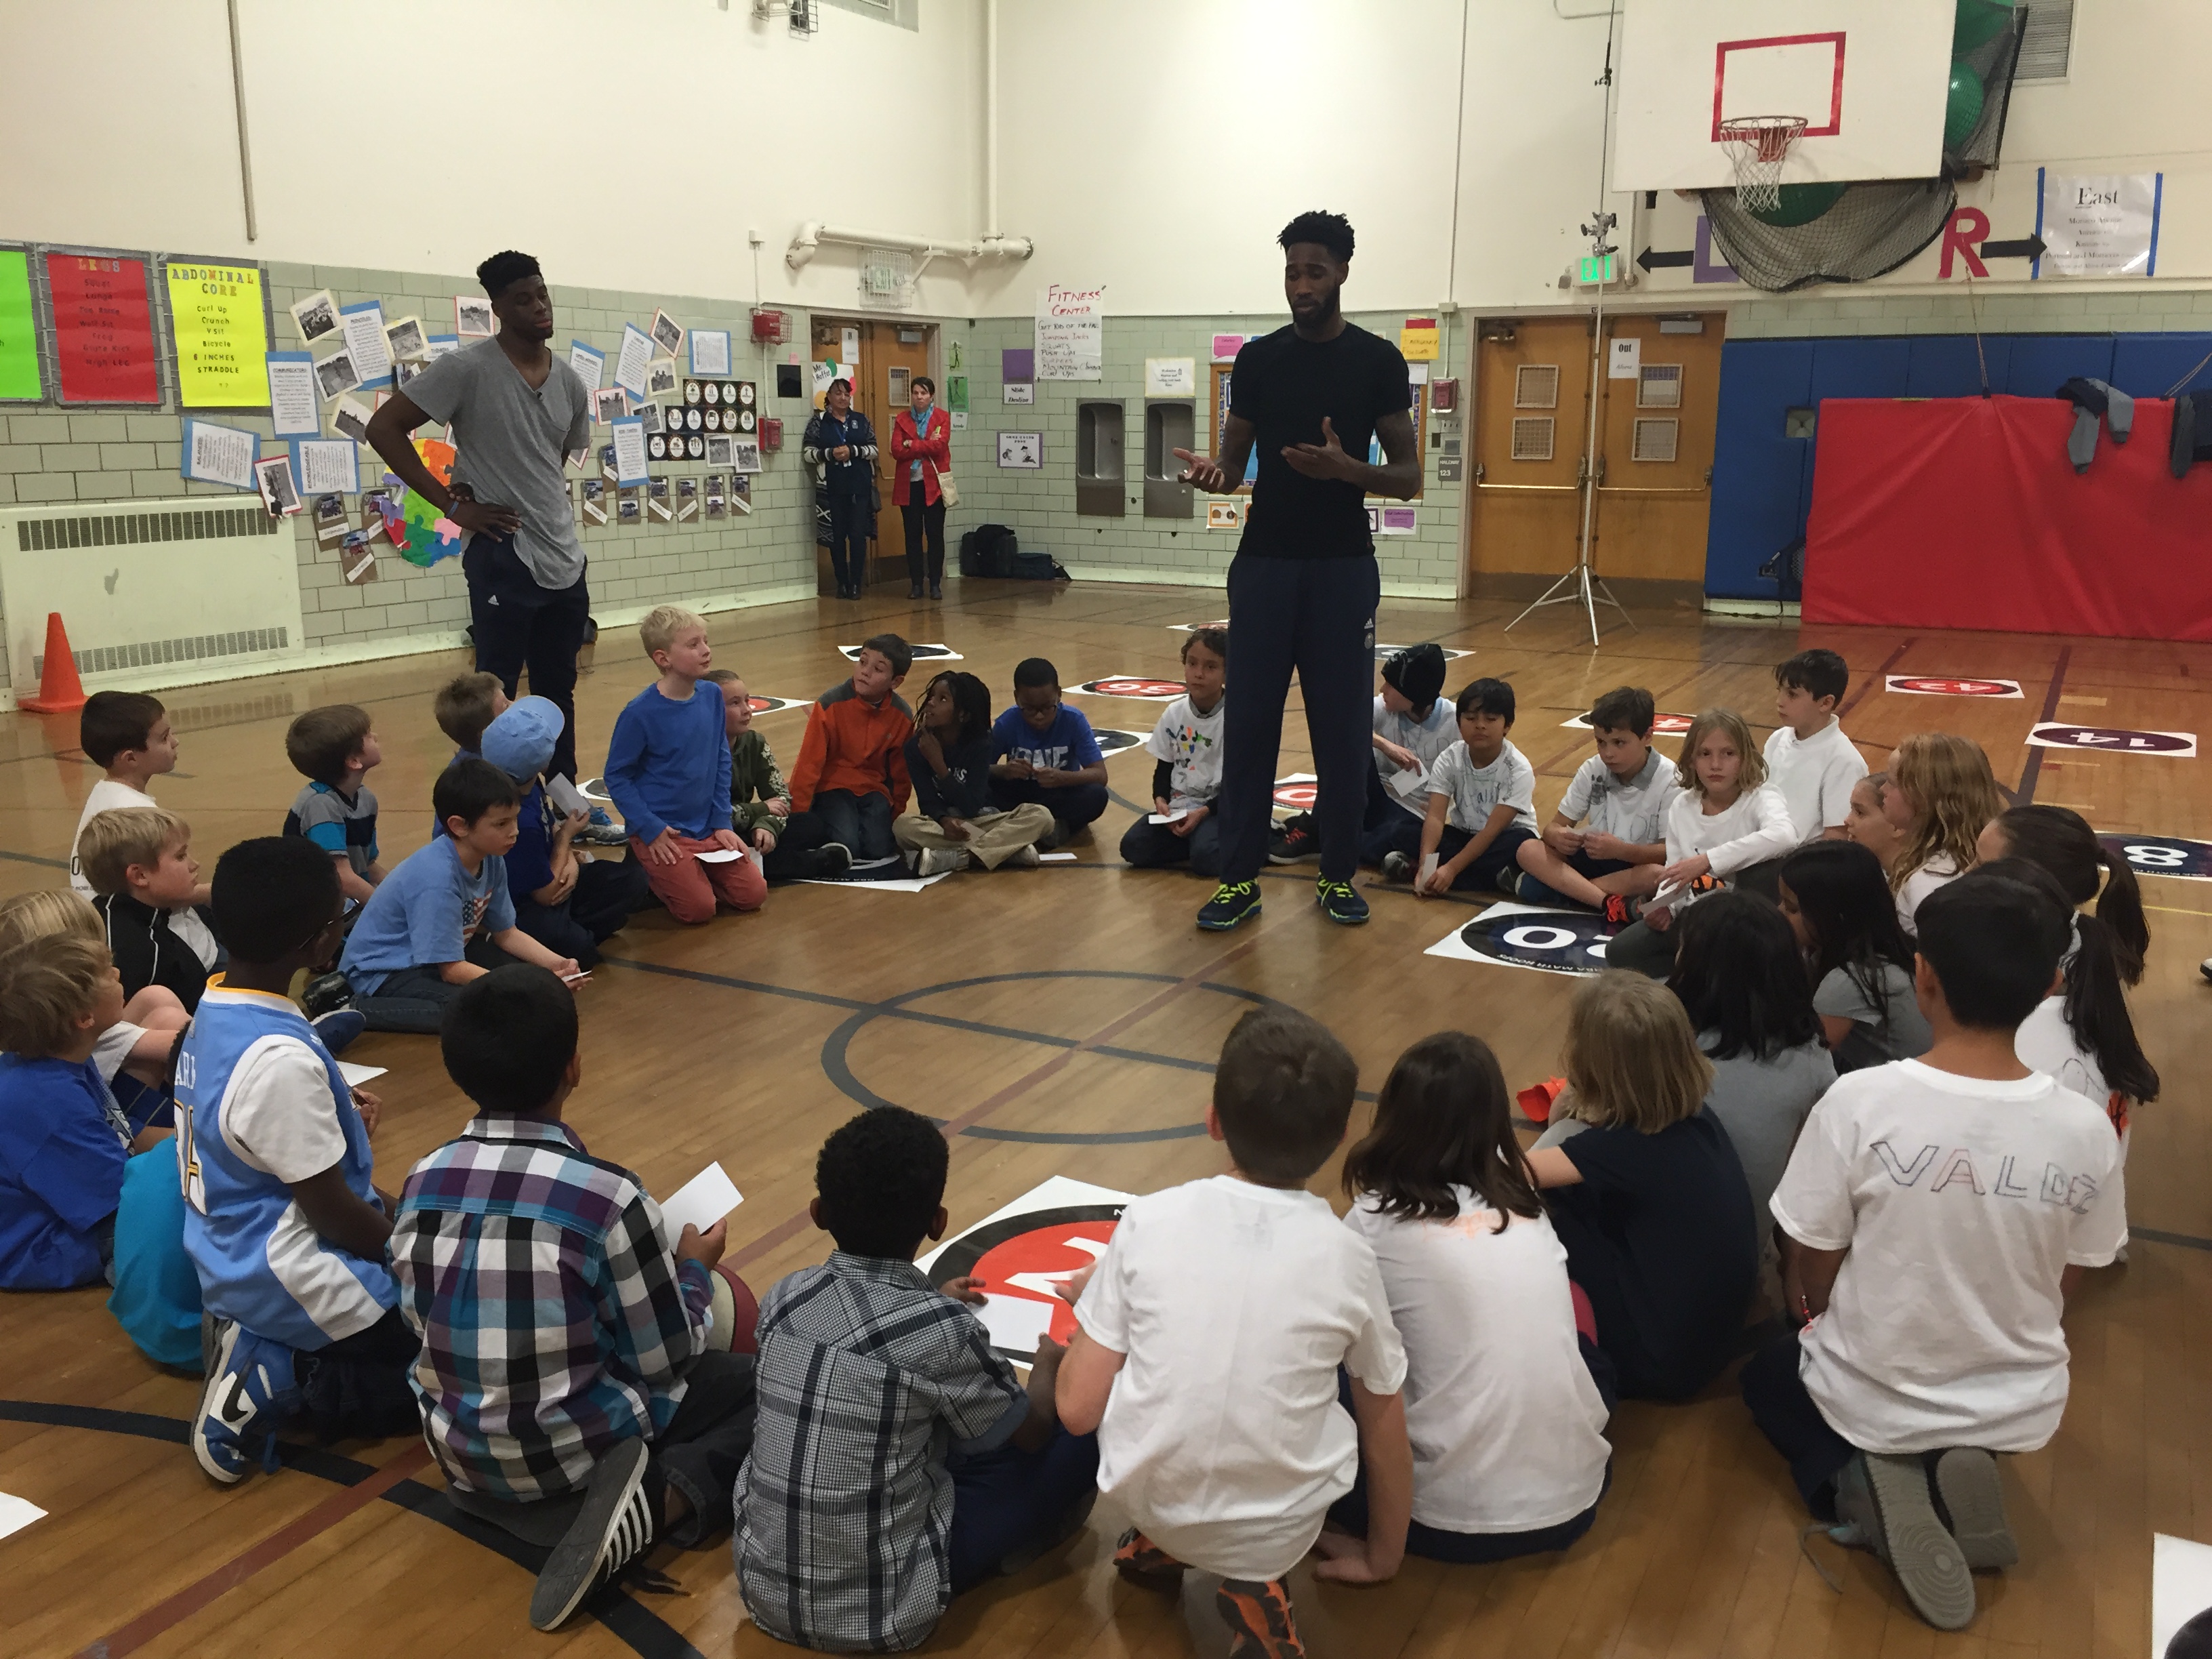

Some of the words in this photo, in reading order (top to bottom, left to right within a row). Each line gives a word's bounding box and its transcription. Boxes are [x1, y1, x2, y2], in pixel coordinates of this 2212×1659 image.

[2077, 186, 2118, 205] East
[1939, 206, 1991, 279] R
[1580, 255, 1612, 282] EXT
[172, 268, 253, 284] ABDOMINAL
[202, 283, 237, 296] CORE
[1048, 285, 1101, 302] FITNESS
[1052, 305, 1091, 316] CENTER
[202, 316, 230, 325] Crunch
[1618, 344, 1632, 352] Out
[197, 366, 239, 374] STRADDLE
[1099, 681, 1184, 695] 36
[2070, 731, 2156, 747] 14
[2123, 845, 2189, 866] 8
[1496, 953, 1536, 966] HOOPS
[1536, 961, 1574, 970] MATH
